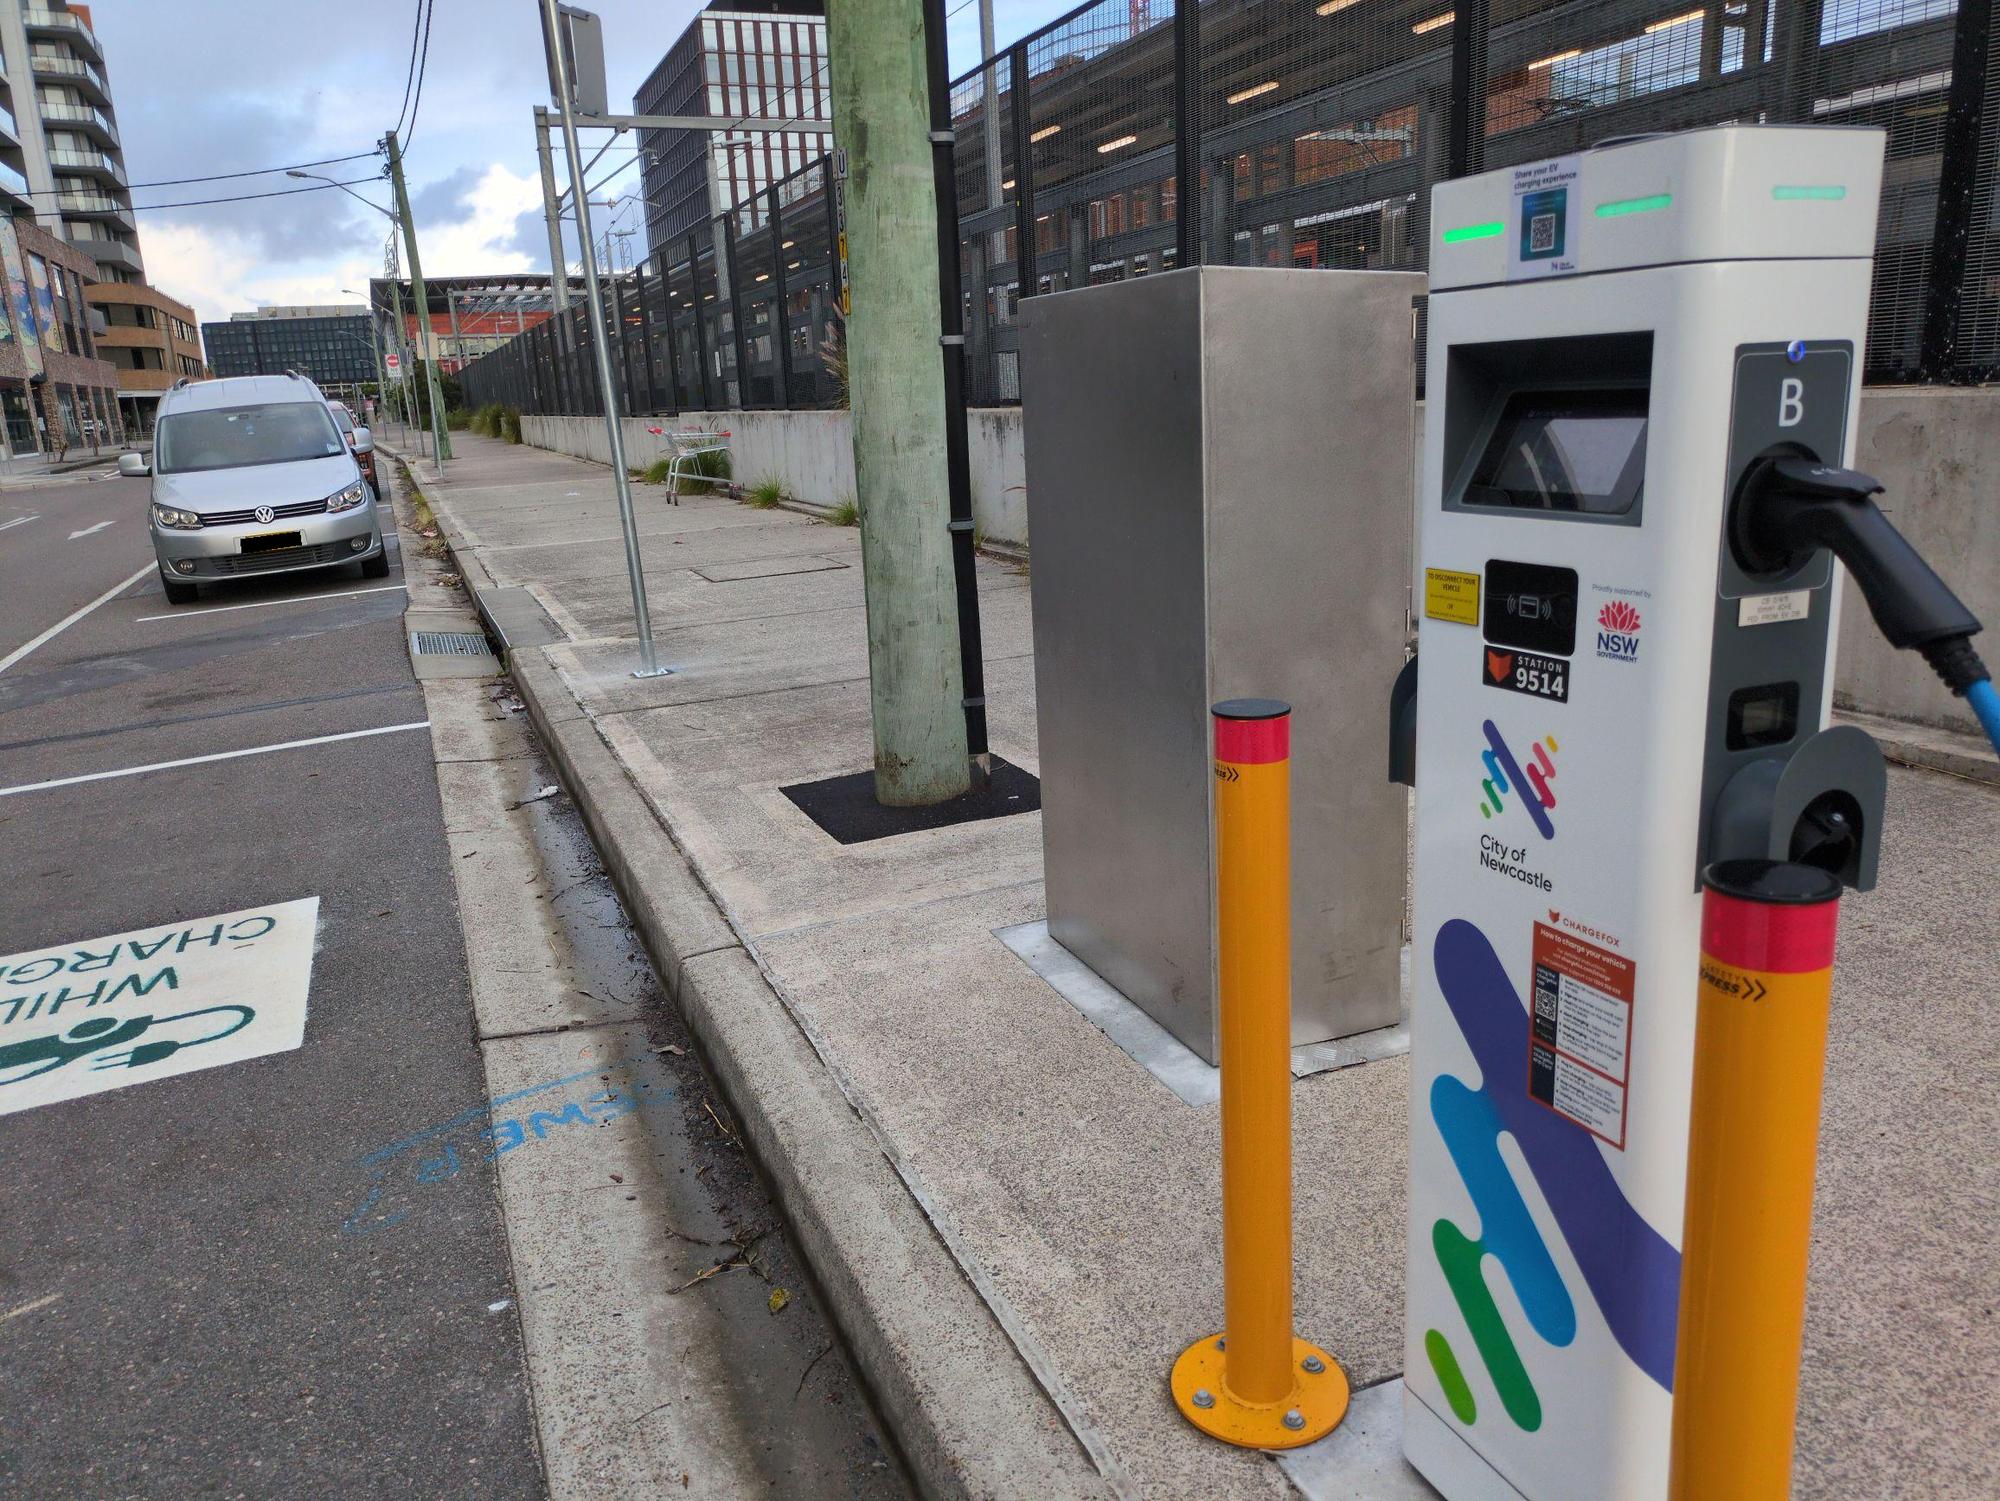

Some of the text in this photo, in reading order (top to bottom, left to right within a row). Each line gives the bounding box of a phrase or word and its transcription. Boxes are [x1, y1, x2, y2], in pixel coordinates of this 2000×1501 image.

[1514, 163, 1559, 180] Share your EV
[1514, 178, 1541, 190] charging
[1542, 172, 1577, 185] experience
[1778, 378, 1803, 427] B
[1592, 584, 1652, 599] Proudly supported by
[1596, 651, 1638, 663] GOVERNMENT
[1597, 632, 1640, 655] NSW
[1517, 656, 1563, 673] STATION
[1516, 668, 1565, 698] 9514
[1480, 834, 1526, 864] City of
[1480, 851, 1552, 892] Newcastle
[1563, 918, 1620, 948] CHARGEFOX
[1562, 937, 1584, 955] charge
[1586, 948, 1600, 961] your
[1601, 954, 1626, 971] vehicle
[0, 966, 178, 1024] WHIL
